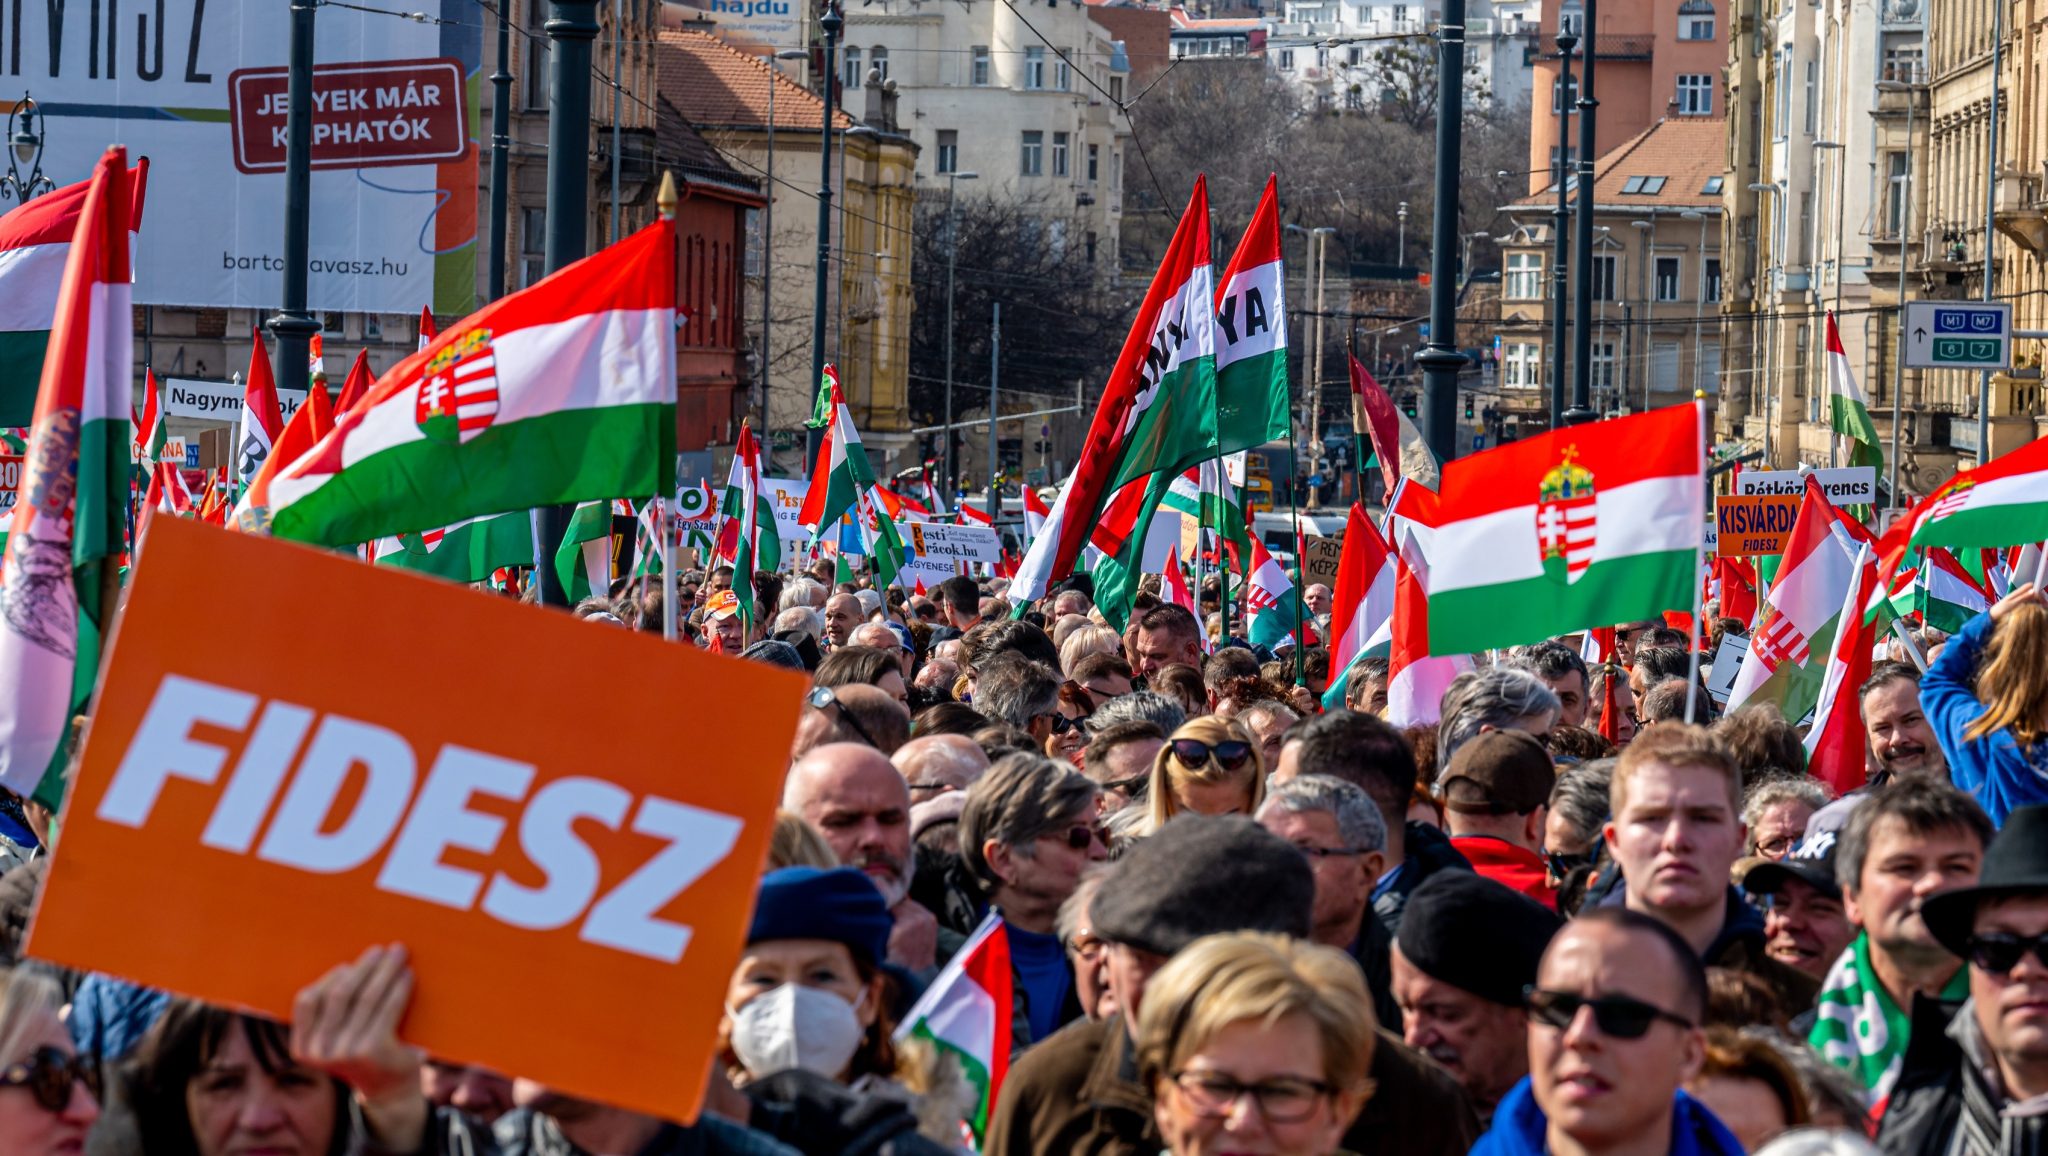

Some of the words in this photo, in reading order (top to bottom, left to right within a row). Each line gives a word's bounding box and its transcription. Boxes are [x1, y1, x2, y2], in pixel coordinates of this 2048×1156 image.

[711, 0, 789, 17] hajdu
[256, 88, 367, 116] JEYEK
[375, 80, 440, 109] MÁR
[272, 114, 431, 147] KPHATÓK
[223, 251, 407, 276] bartoavasz.hu
[1946, 316, 1960, 326] M1
[1975, 316, 1991, 326] M7
[1947, 344, 1955, 354] 6
[1978, 344, 1986, 354] 7
[171, 388, 299, 414] Nagymok
[1744, 481, 1869, 497] Rétközrencs
[1719, 498, 1798, 534] KISVÁRDA
[913, 527, 946, 541] Pesti
[916, 541, 978, 557] Srácok.hu
[1743, 538, 1778, 551] FIDESZ
[95, 673, 743, 964] FIDESZ
